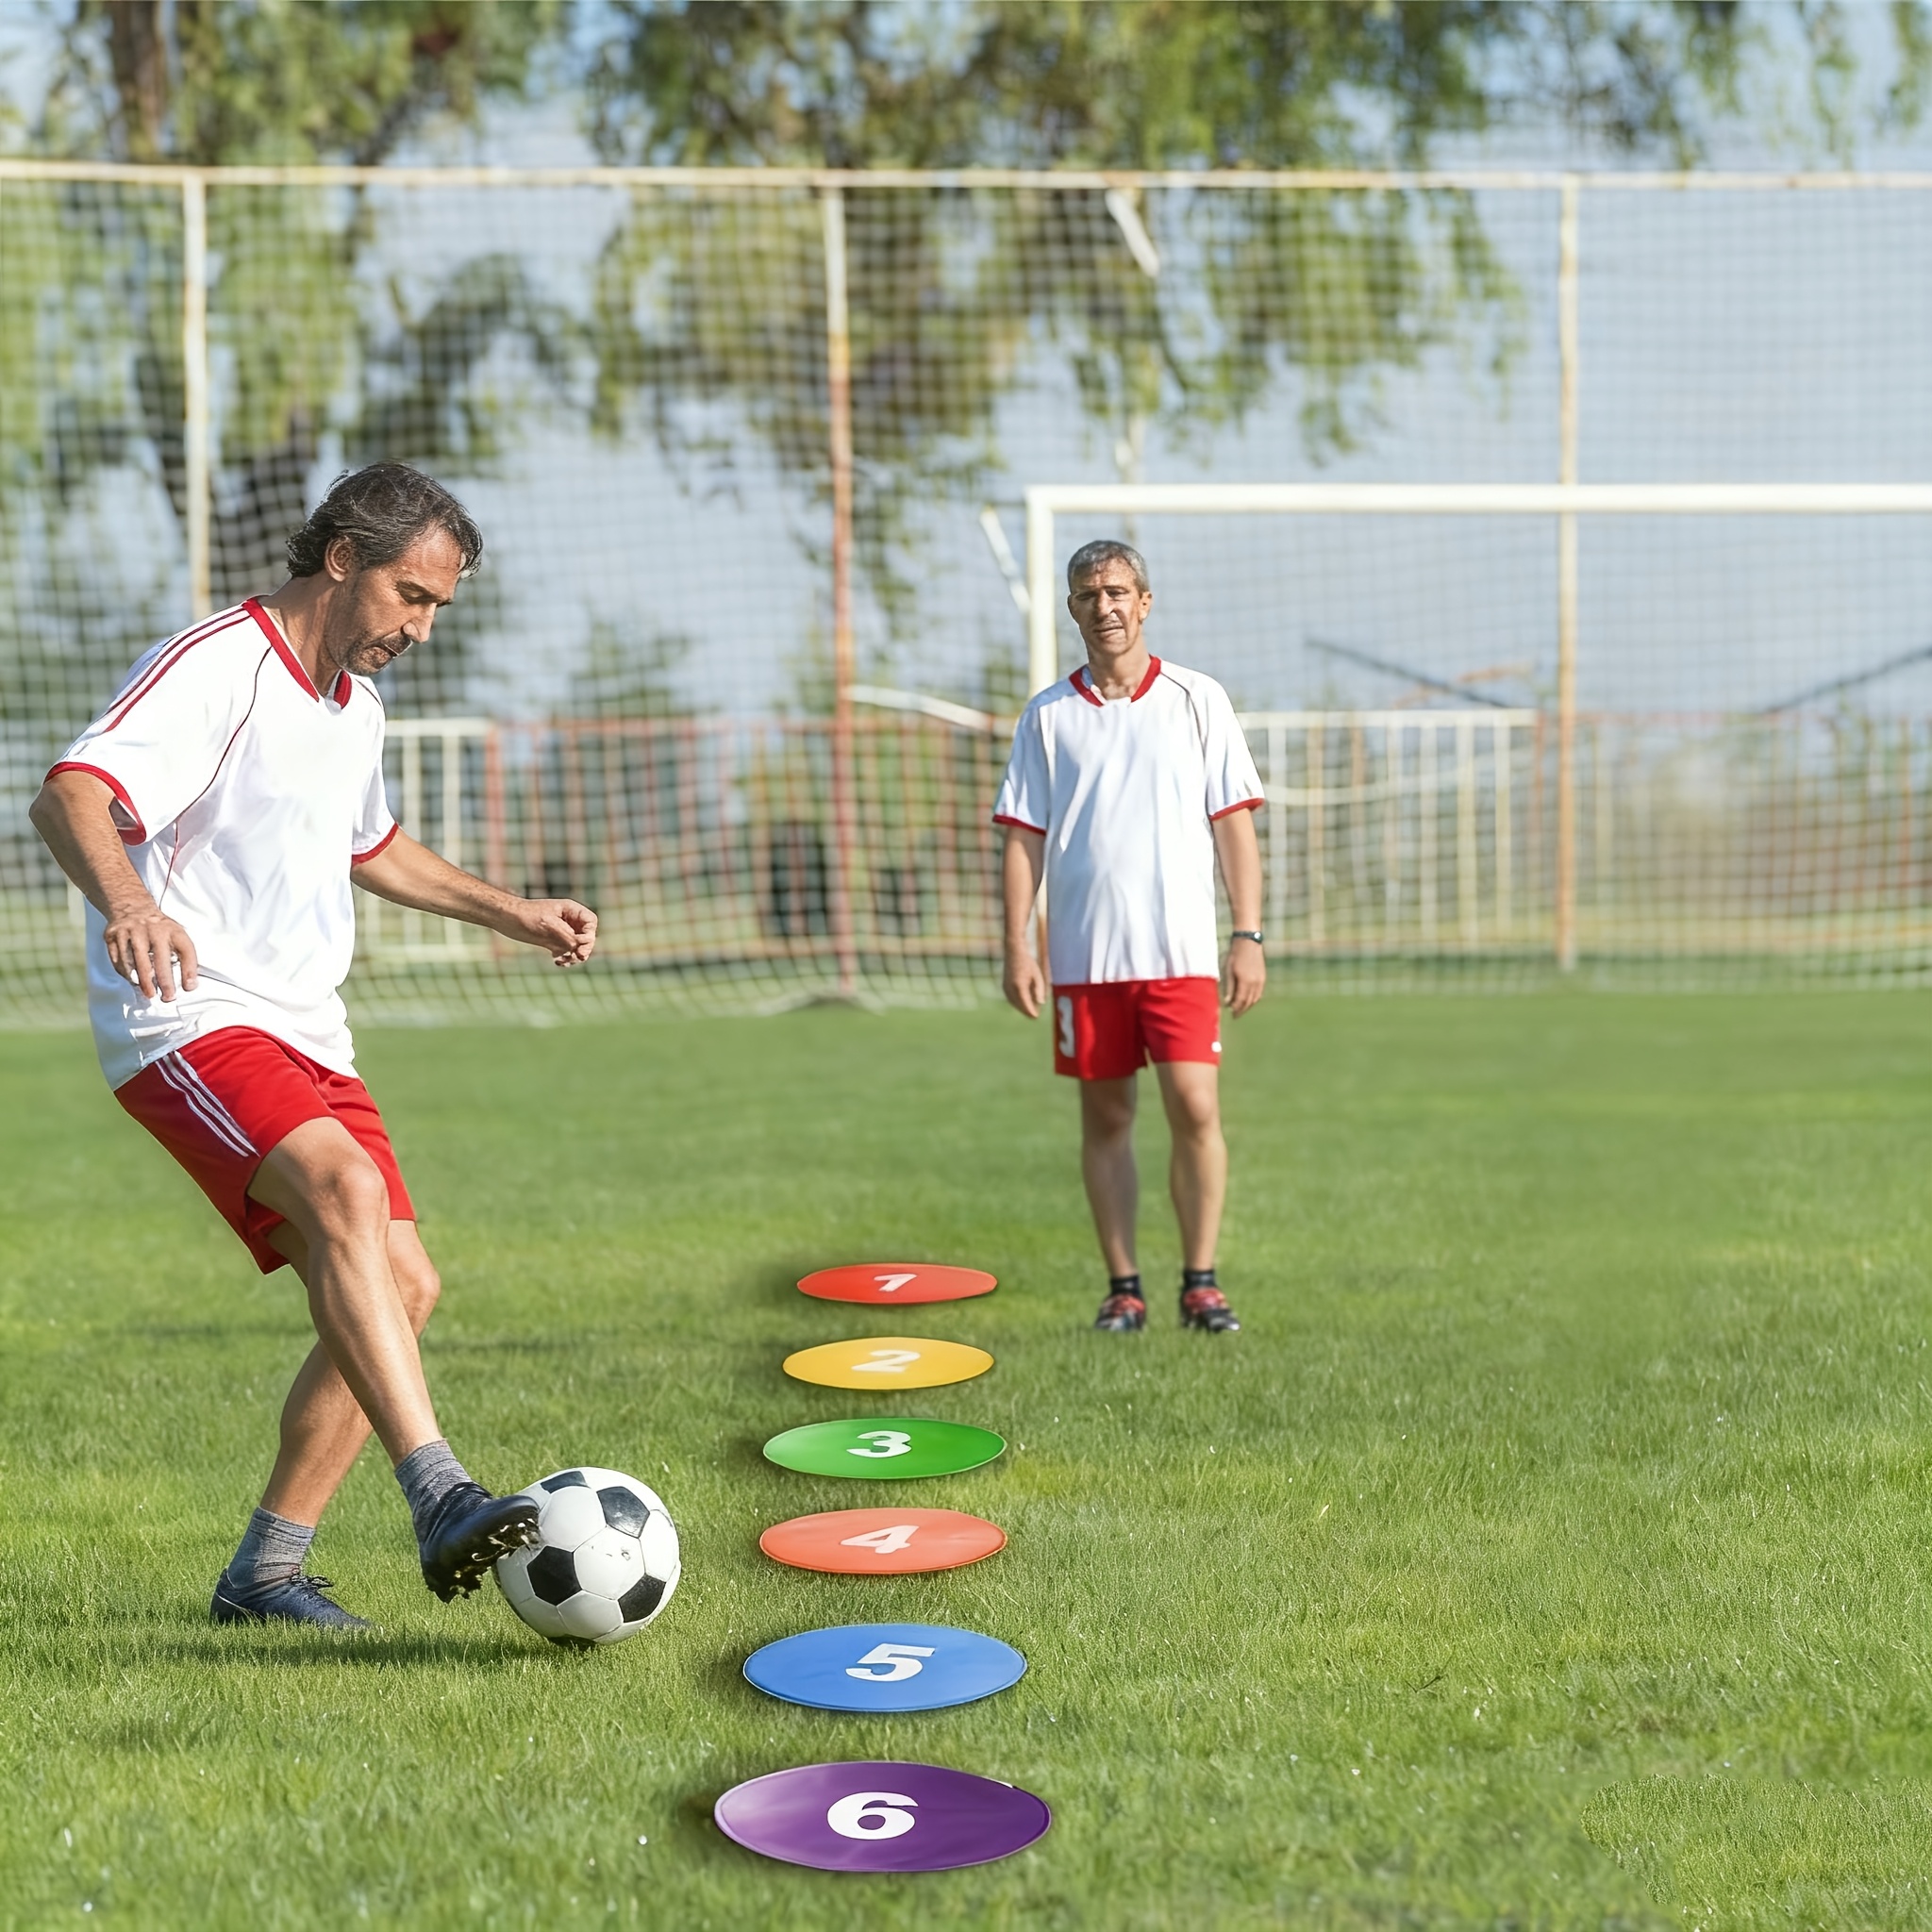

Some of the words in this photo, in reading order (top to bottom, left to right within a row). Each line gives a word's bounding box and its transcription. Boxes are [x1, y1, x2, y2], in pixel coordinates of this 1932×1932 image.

[874, 1273, 917, 1292] 1
[851, 1349, 921, 1373] 2
[846, 1430, 911, 1457] 3
[841, 1524, 919, 1554] 4
[845, 1643, 936, 1682] 5
[826, 1791, 919, 1840] 6
